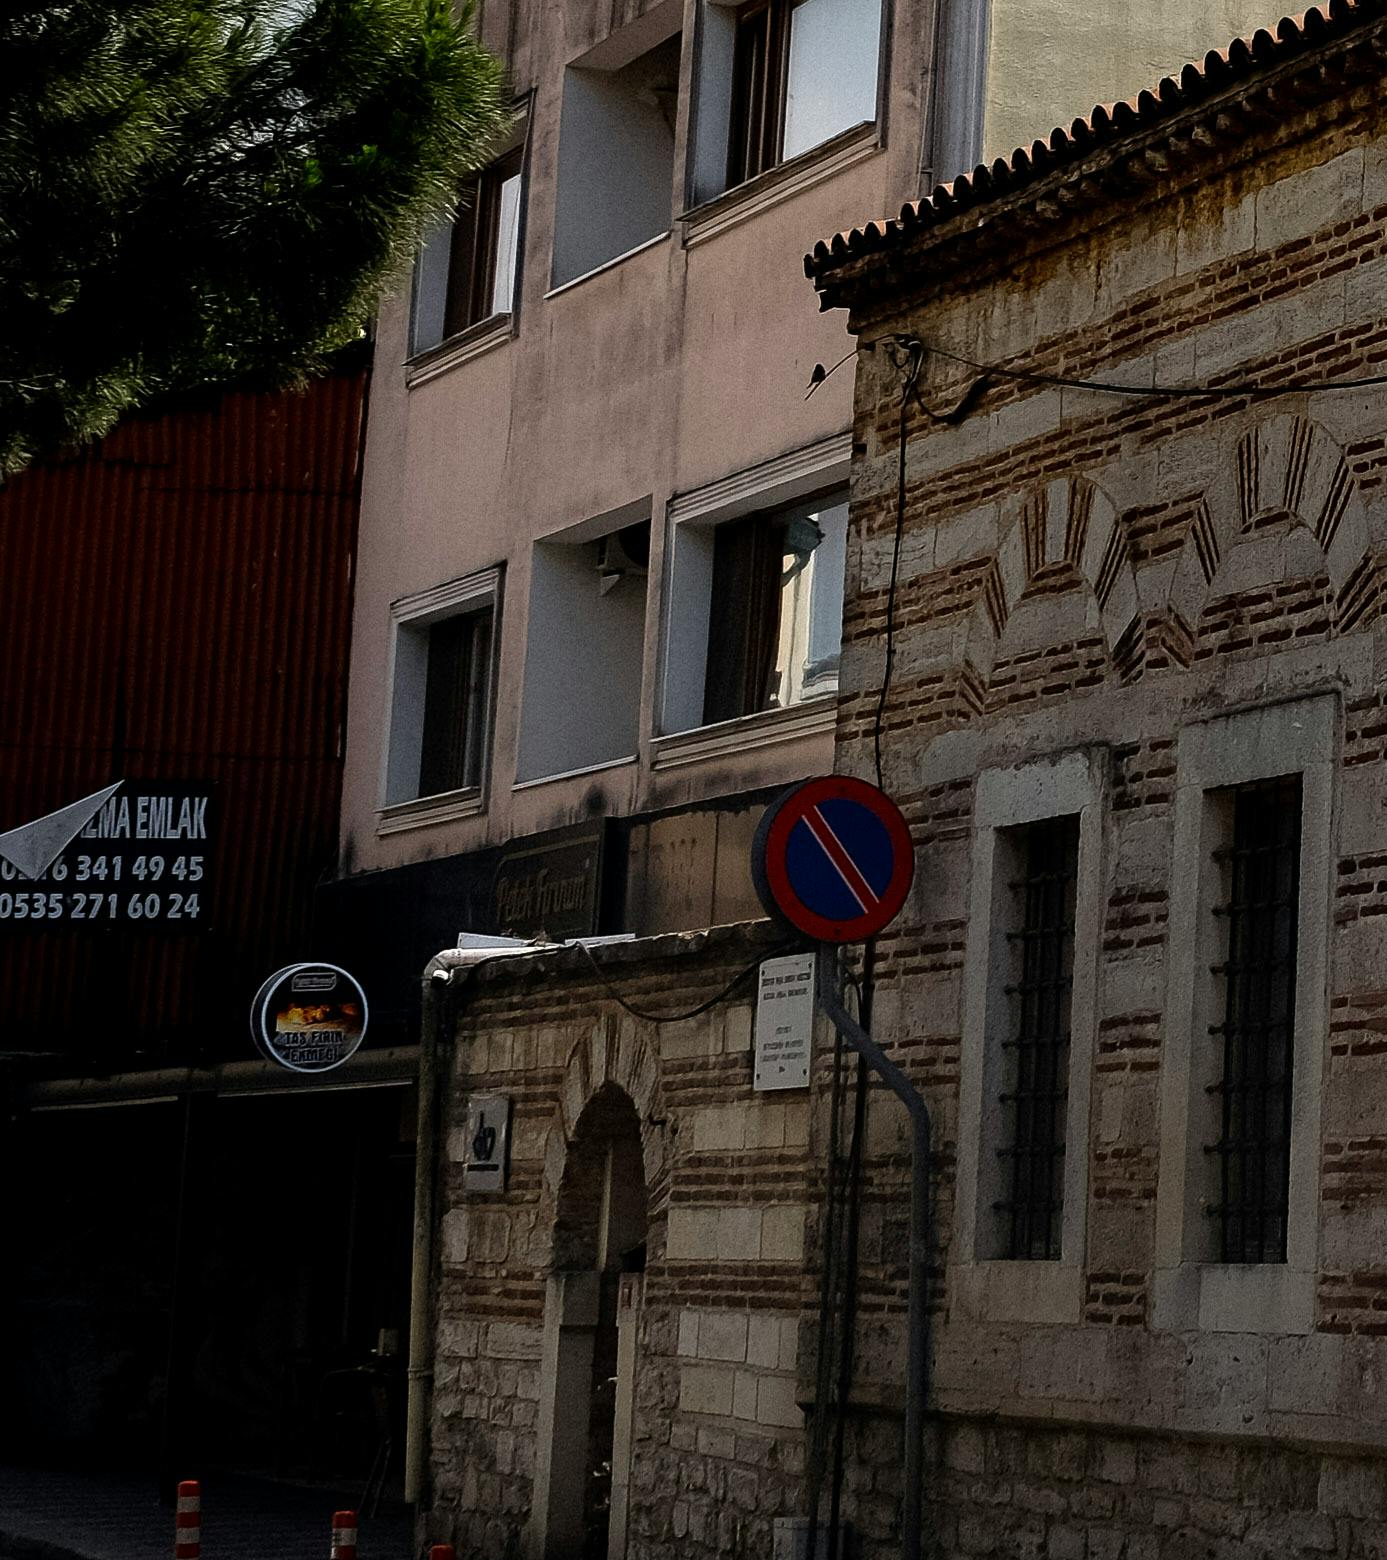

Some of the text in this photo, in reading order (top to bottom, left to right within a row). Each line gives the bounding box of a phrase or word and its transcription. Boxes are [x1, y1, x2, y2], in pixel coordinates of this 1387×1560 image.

[136, 797, 208, 839] EMLAK
[1, 855, 204, 881] 06 341 49 45
[0, 893, 200, 919] 0535 271 60 24
